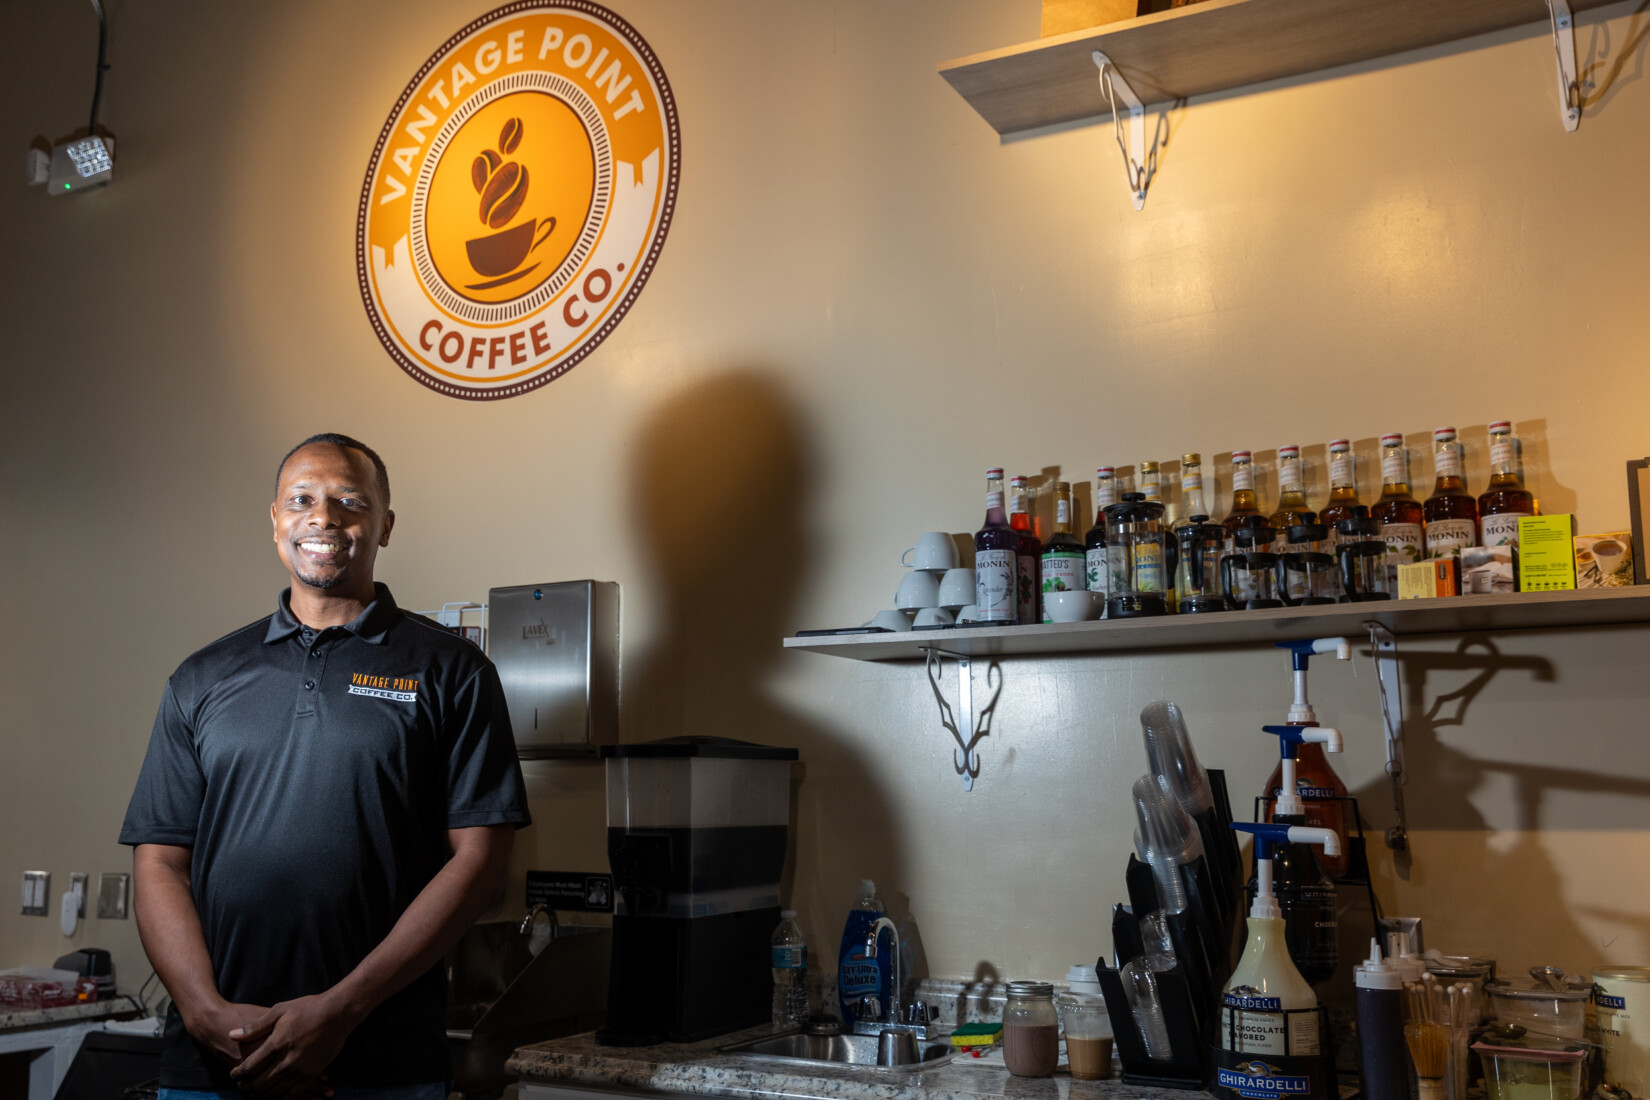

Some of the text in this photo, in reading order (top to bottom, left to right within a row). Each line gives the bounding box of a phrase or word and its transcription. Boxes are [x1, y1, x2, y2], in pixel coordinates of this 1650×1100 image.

[380, 26, 645, 206] VANTAGE POINT
[418, 262, 626, 370] COFFEE CO.
[1386, 534, 1418, 543] ONIN
[1428, 531, 1469, 541] MONIN
[977, 560, 1010, 569] MONIN
[352, 672, 419, 691] VANTAGE POINT
[352, 687, 413, 701] COFFEE CO.
[844, 975, 876, 985] Deluxe
[1224, 996, 1278, 1009] HIRARDELLI
[1236, 1024, 1285, 1034] CHOCOLATE
[1219, 1072, 1306, 1091] GHIRARDELLI
